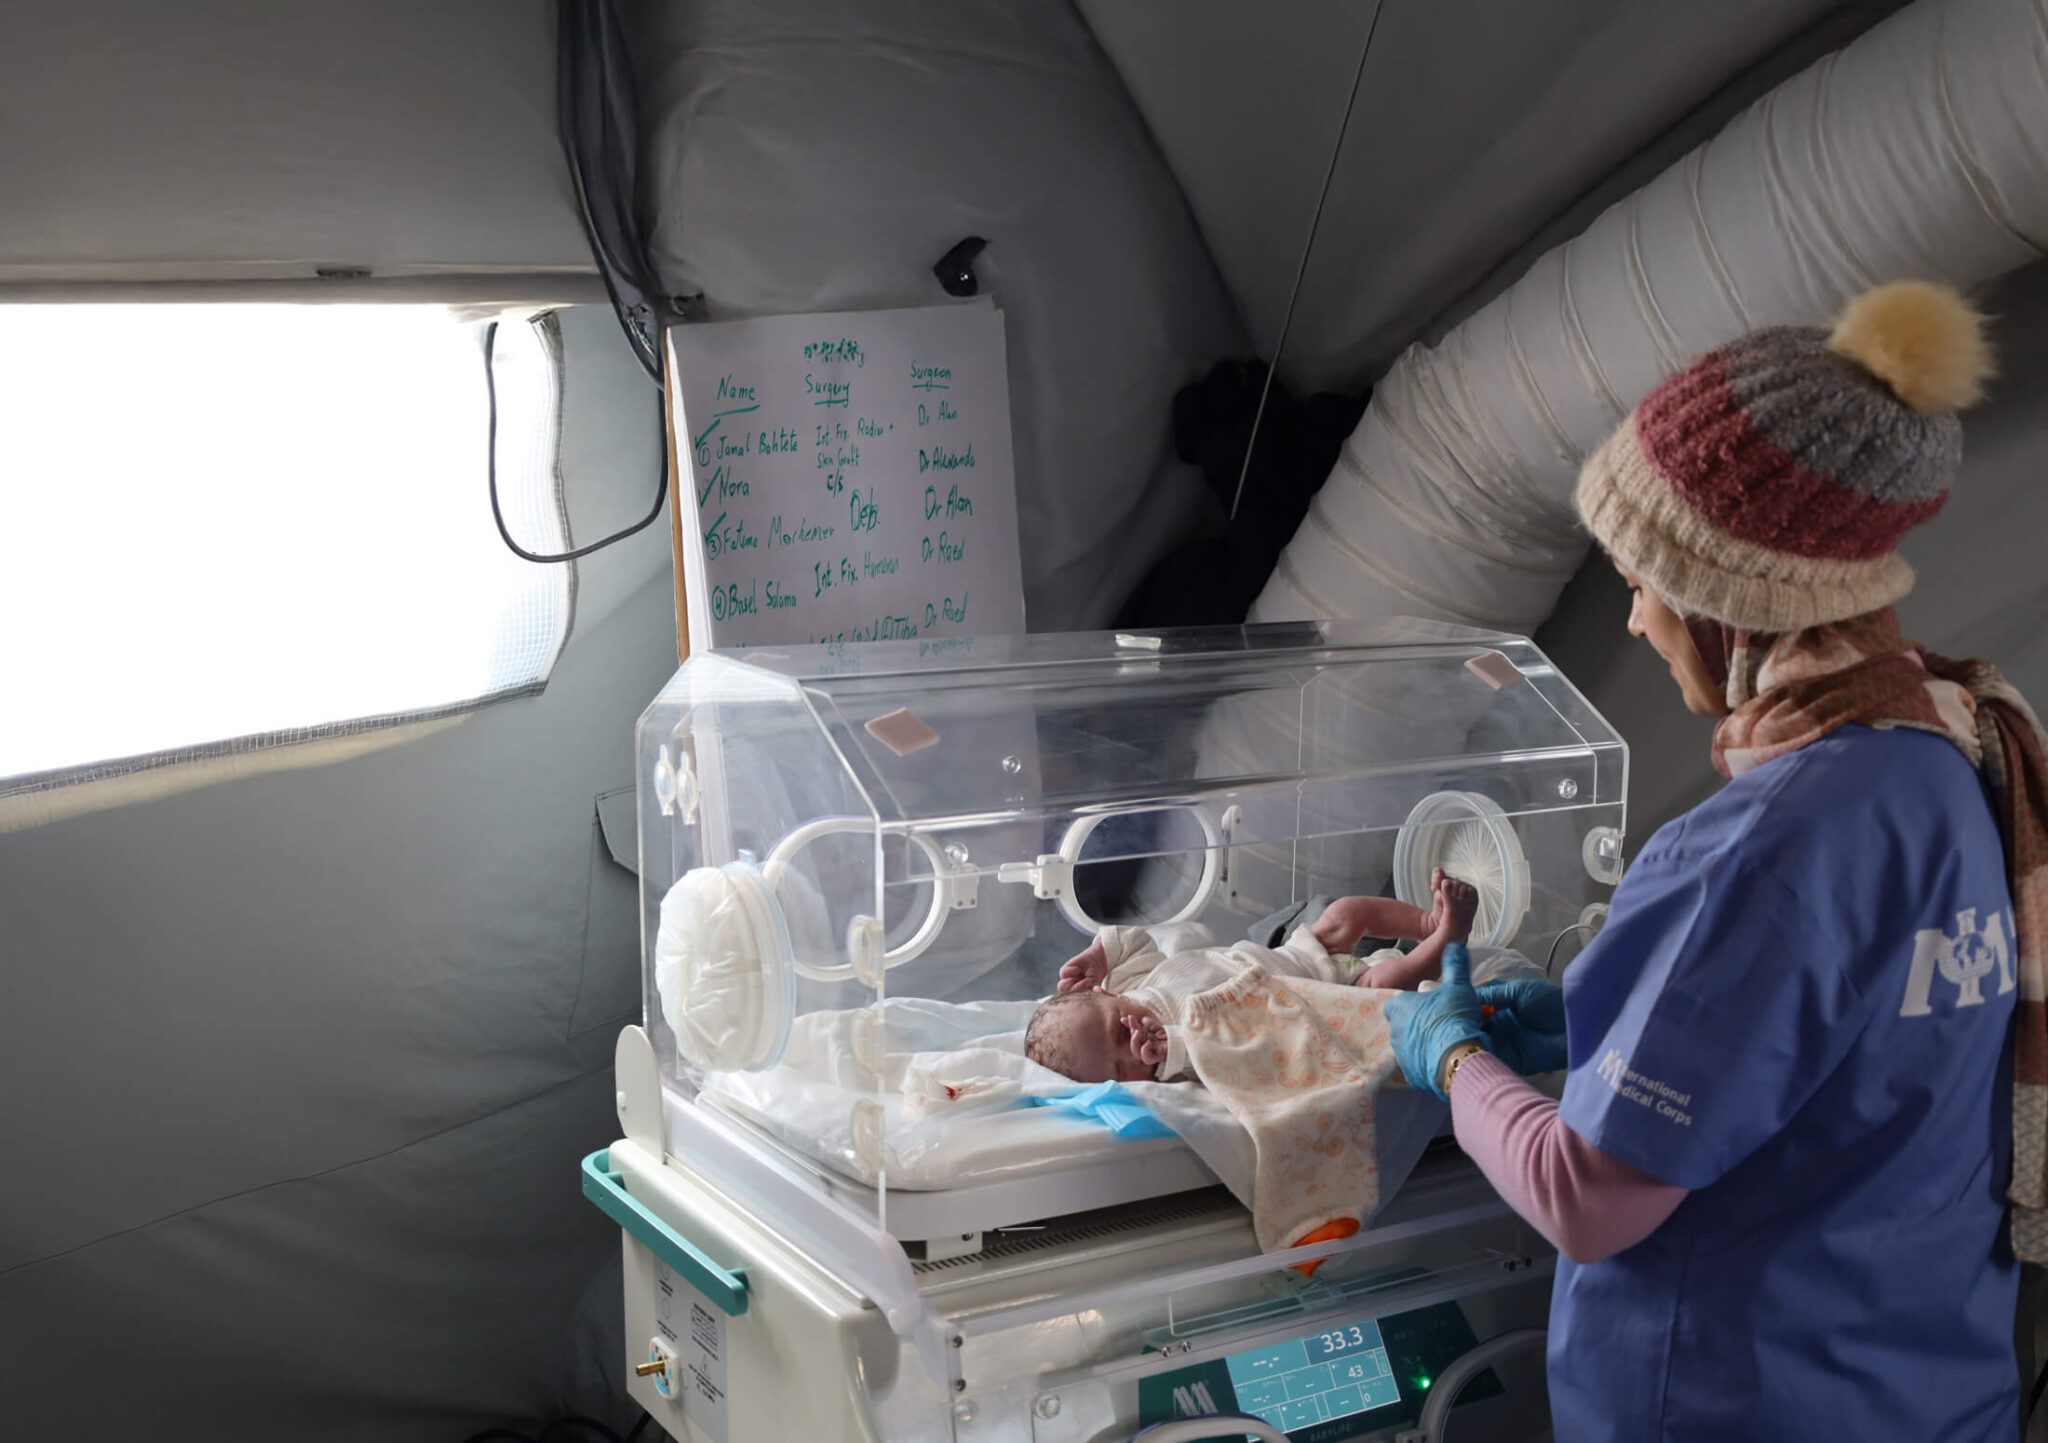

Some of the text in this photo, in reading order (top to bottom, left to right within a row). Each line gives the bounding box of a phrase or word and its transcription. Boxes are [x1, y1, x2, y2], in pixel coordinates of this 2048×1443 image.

[716, 373, 757, 401] Name
[718, 466, 750, 505] Nora
[925, 483, 973, 520] Dr Alan
[922, 530, 966, 564] Dr Raed
[924, 602, 938, 629] Dr
[1655, 1099, 1693, 1126] Corps
[1320, 1326, 1364, 1353] 33.3
[1347, 1364, 1364, 1379] 43
